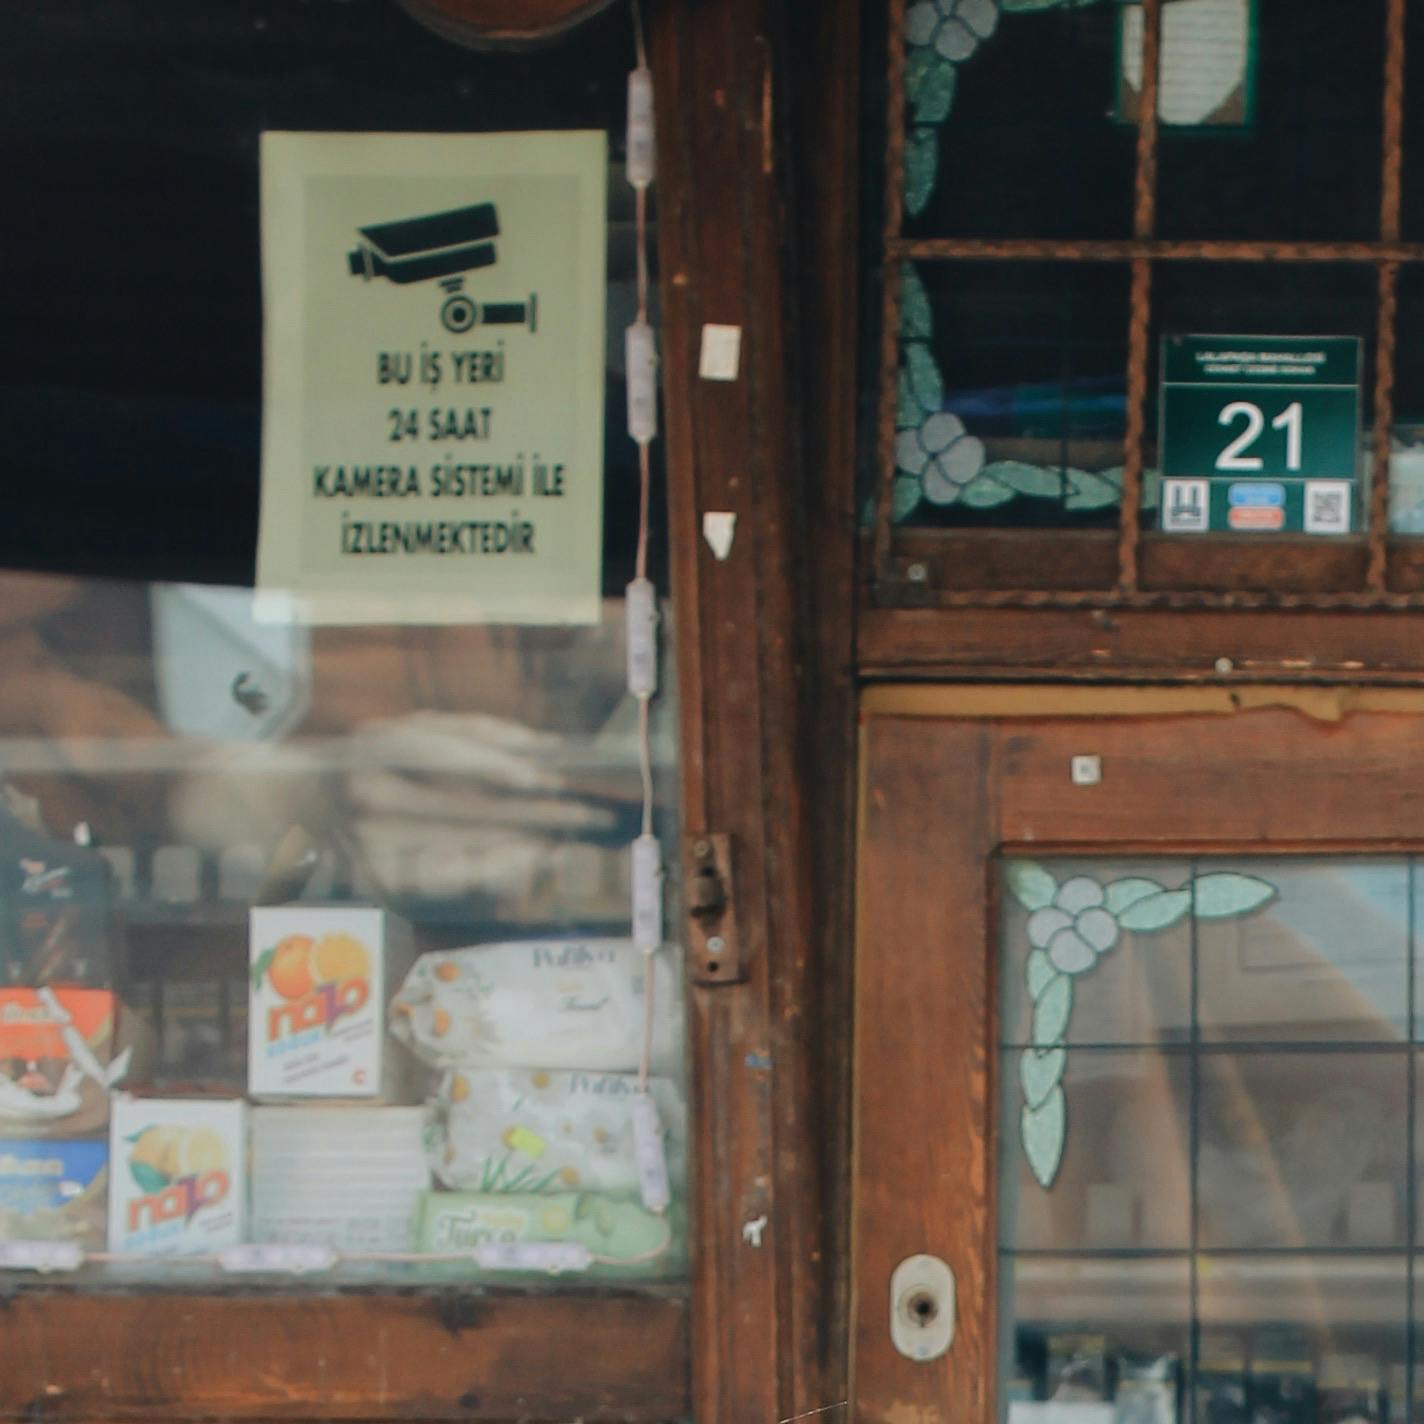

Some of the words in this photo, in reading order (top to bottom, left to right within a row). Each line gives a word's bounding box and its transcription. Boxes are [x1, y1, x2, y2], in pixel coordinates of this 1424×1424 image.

[378, 350, 410, 384] BU
[419, 341, 443, 391] İŞ
[452, 340, 505, 384] YERİ
[388, 408, 420, 442] 24
[429, 407, 493, 441] SAAT
[1214, 401, 1303, 471] 21
[313, 464, 422, 498] KAMERA
[430, 452, 525, 498] SİSTEMİ
[531, 453, 566, 497] İLE
[340, 509, 536, 556] İZLENMEKTEDİR
